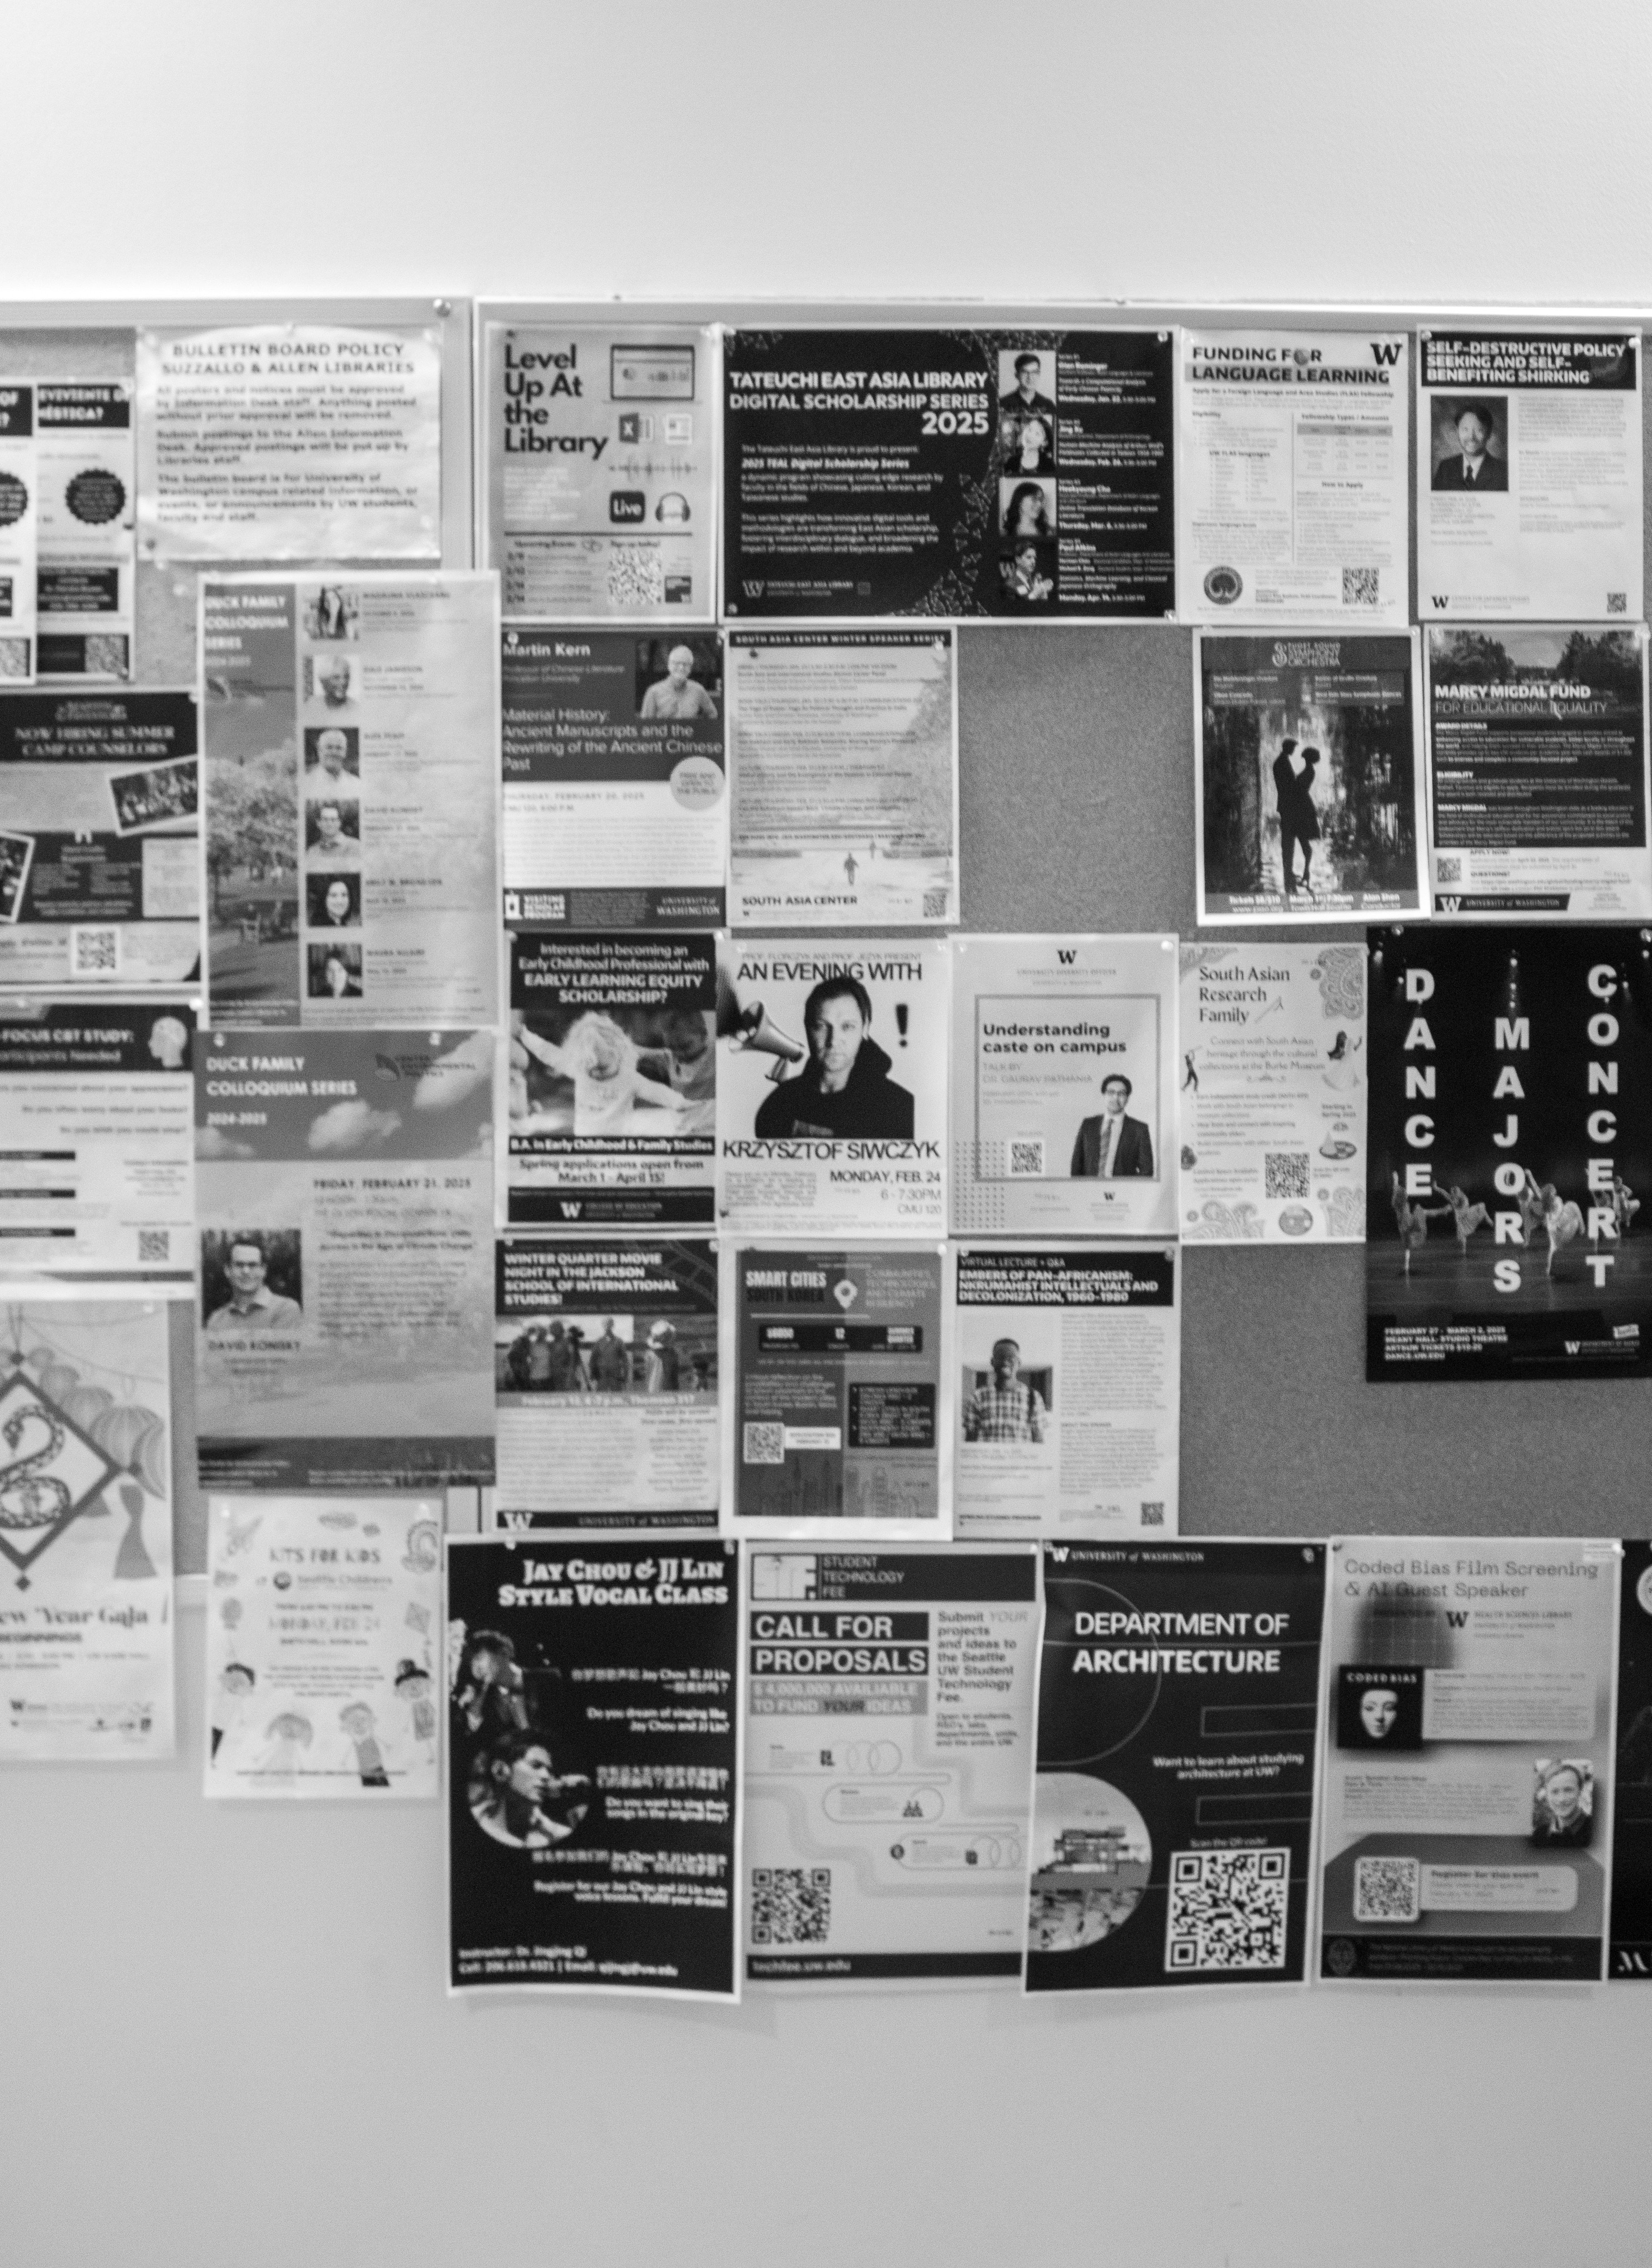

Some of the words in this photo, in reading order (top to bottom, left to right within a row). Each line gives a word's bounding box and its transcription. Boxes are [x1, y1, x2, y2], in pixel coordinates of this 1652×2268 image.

[174, 344, 260, 355] BULLETIN
[268, 344, 330, 356] BOARD
[338, 344, 402, 355] POLICY
[1194, 348, 1276, 361] FUNDING
[1371, 344, 1402, 365] W
[1428, 342, 1570, 356] SELF-DESTRUCTIVE
[1574, 344, 1624, 356] POLICY
[505, 344, 576, 370] Level
[1428, 356, 1490, 368] SEEKING
[1494, 357, 1526, 368] AND
[1529, 357, 1571, 369] SELF-
[163, 363, 244, 374] SUZZALLO
[252, 362, 260, 373] &
[269, 363, 318, 374] ALLEN
[325, 363, 413, 373] LIBRARIES
[731, 373, 818, 388] TATEUCHI
[821, 373, 866, 388] EAST
[870, 373, 910, 388] ASIA
[914, 373, 987, 387] LIBRARY
[1193, 368, 1291, 381] LANGUAGE
[1297, 369, 1388, 383] LEARNING
[1427, 370, 1514, 381] BENEFITING
[1519, 370, 1589, 383] SHIRKING
[505, 371, 544, 403] Up
[550, 373, 581, 397] At
[730, 394, 799, 408] DIGITAL
[805, 394, 926, 408] SCHOLARSHIP
[931, 395, 988, 408] SERIES
[504, 400, 548, 425] the
[923, 412, 988, 434] 2025
[504, 426, 608, 460] Library
[614, 501, 641, 515] Live
[503, 644, 551, 655] Martin
[555, 644, 590, 655] Kern
[1436, 686, 1487, 699] MARCY
[1491, 686, 1547, 698] MIGDAL
[1550, 686, 1590, 697] FUND
[504, 709, 554, 720] Material
[504, 726, 552, 737] Ancient
[556, 724, 637, 739] Manuscripts
[642, 726, 667, 736] and
[672, 725, 693, 736] the
[504, 741, 564, 757] Rewriting
[568, 741, 581, 753] of
[585, 742, 606, 753] the
[611, 741, 662, 753] Ancient
[666, 740, 722, 754] Chinese
[541, 945, 599, 954] Interested
[602, 944, 612, 954] in
[615, 945, 672, 958] becoming
[519, 958, 548, 971] Early
[551, 958, 608, 969] Childhood
[610, 957, 681, 970] Professional
[684, 957, 709, 970] with
[738, 963, 767, 980] AN
[773, 963, 863, 980] EVENING
[868, 963, 921, 980] WITH
[1199, 967, 1244, 981] South
[1249, 967, 1290, 981] Asian
[525, 974, 569, 986] EARLY
[573, 975, 645, 986] LEARNING
[649, 975, 702, 988] EQUITY
[560, 990, 667, 1002] SCHOLARSHIP?
[1200, 987, 1266, 1001] Research
[1200, 1007, 1248, 1024] Family
[984, 1023, 1110, 1038] Understanding
[983, 1042, 1028, 1052] caste
[1034, 1044, 1054, 1052] on
[1060, 1043, 1126, 1054] campus
[207, 1058, 248, 1070] DUCK
[253, 1058, 303, 1070] FAMILY
[207, 1082, 307, 1095] COLLOQUIUM
[312, 1082, 356, 1094] SERIES
[1404, 969, 1436, 1196] DANCE
[1586, 965, 1619, 1287] CONCERT
[510, 1140, 529, 1149] B.A.
[546, 1140, 571, 1151] Early
[574, 1140, 626, 1149] Childhood
[638, 1140, 672, 1151] Family
[674, 1140, 712, 1149] Studies
[723, 1140, 843, 1159] KRZYSZTOF
[847, 1140, 939, 1159] SIWCZYK
[1493, 1018, 1529, 1292] MAJORS
[520, 1159, 559, 1171] Spring
[563, 1159, 637, 1171] applications
[641, 1162, 671, 1171] open
[674, 1159, 703, 1168] from
[830, 1171, 894, 1183] MONDAY,
[896, 1172, 921, 1182] FEB.
[927, 1172, 940, 1183] 24
[506, 1254, 555, 1263] WINTER
[558, 1254, 617, 1265] QUARTER
[621, 1254, 660, 1263] MOVIE
[506, 1268, 543, 1277] NIGHT
[561, 1267, 586, 1277] THE
[590, 1268, 644, 1277] JACKSON
[747, 1272, 786, 1285] SMART
[791, 1273, 826, 1286] CITIES
[960, 1271, 1007, 1280] EMBERS
[1009, 1271, 1024, 1280] OF
[506, 1281, 553, 1290] SCHOOL
[558, 1281, 573, 1290] OF
[577, 1280, 679, 1290] INTERNATIONAL
[960, 1281, 1037, 1291] NKRUMAHIST
[1041, 1281, 1132, 1291] INTELLECTUALS
[1133, 1282, 1157, 1290] AND
[959, 1292, 1063, 1303] DECOLONIZATION,
[1067, 1292, 1128, 1301] 1960-1980
[824, 1556, 876, 1567] STUDENT
[1053, 1548, 1068, 1561] W
[524, 1560, 565, 1584] JAY
[567, 1560, 631, 1580] CHOU
[635, 1559, 656, 1579] &
[660, 1560, 677, 1583] JJ
[683, 1559, 723, 1578] LIN
[824, 1571, 903, 1582] TECHNOLOGY
[1345, 1559, 1405, 1576] Coded
[1411, 1561, 1450, 1575] Bias
[1457, 1560, 1499, 1575] Film
[1505, 1561, 1598, 1580] Screening
[500, 1585, 572, 1605] STYLE
[576, 1585, 652, 1605] VOCAL
[655, 1584, 727, 1603] CLASS
[823, 1586, 846, 1598] FEE
[1345, 1582, 1360, 1596] &
[1369, 1583, 1389, 1596] AI
[1395, 1582, 1448, 1597] Guest
[1455, 1583, 1528, 1599] Speaker
[939, 1613, 983, 1622] Submit
[1076, 1613, 1251, 1635] DEPARTMENT
[1255, 1614, 1289, 1635] OF
[756, 1616, 828, 1638] CALL
[837, 1616, 892, 1638] FOR
[938, 1627, 990, 1637] projects
[938, 1640, 961, 1648] and
[757, 1650, 926, 1672] PROPOSALS
[938, 1653, 957, 1662] the
[963, 1653, 1005, 1661] Seattle
[1073, 1650, 1279, 1672] ARCHITECTURE
[965, 1666, 1013, 1674] Student
[939, 1679, 1011, 1691] Technology
[1154, 1758, 1181, 1766] Want
[1227, 1756, 1256, 1765] about
[1259, 1754, 1303, 1765] studying
